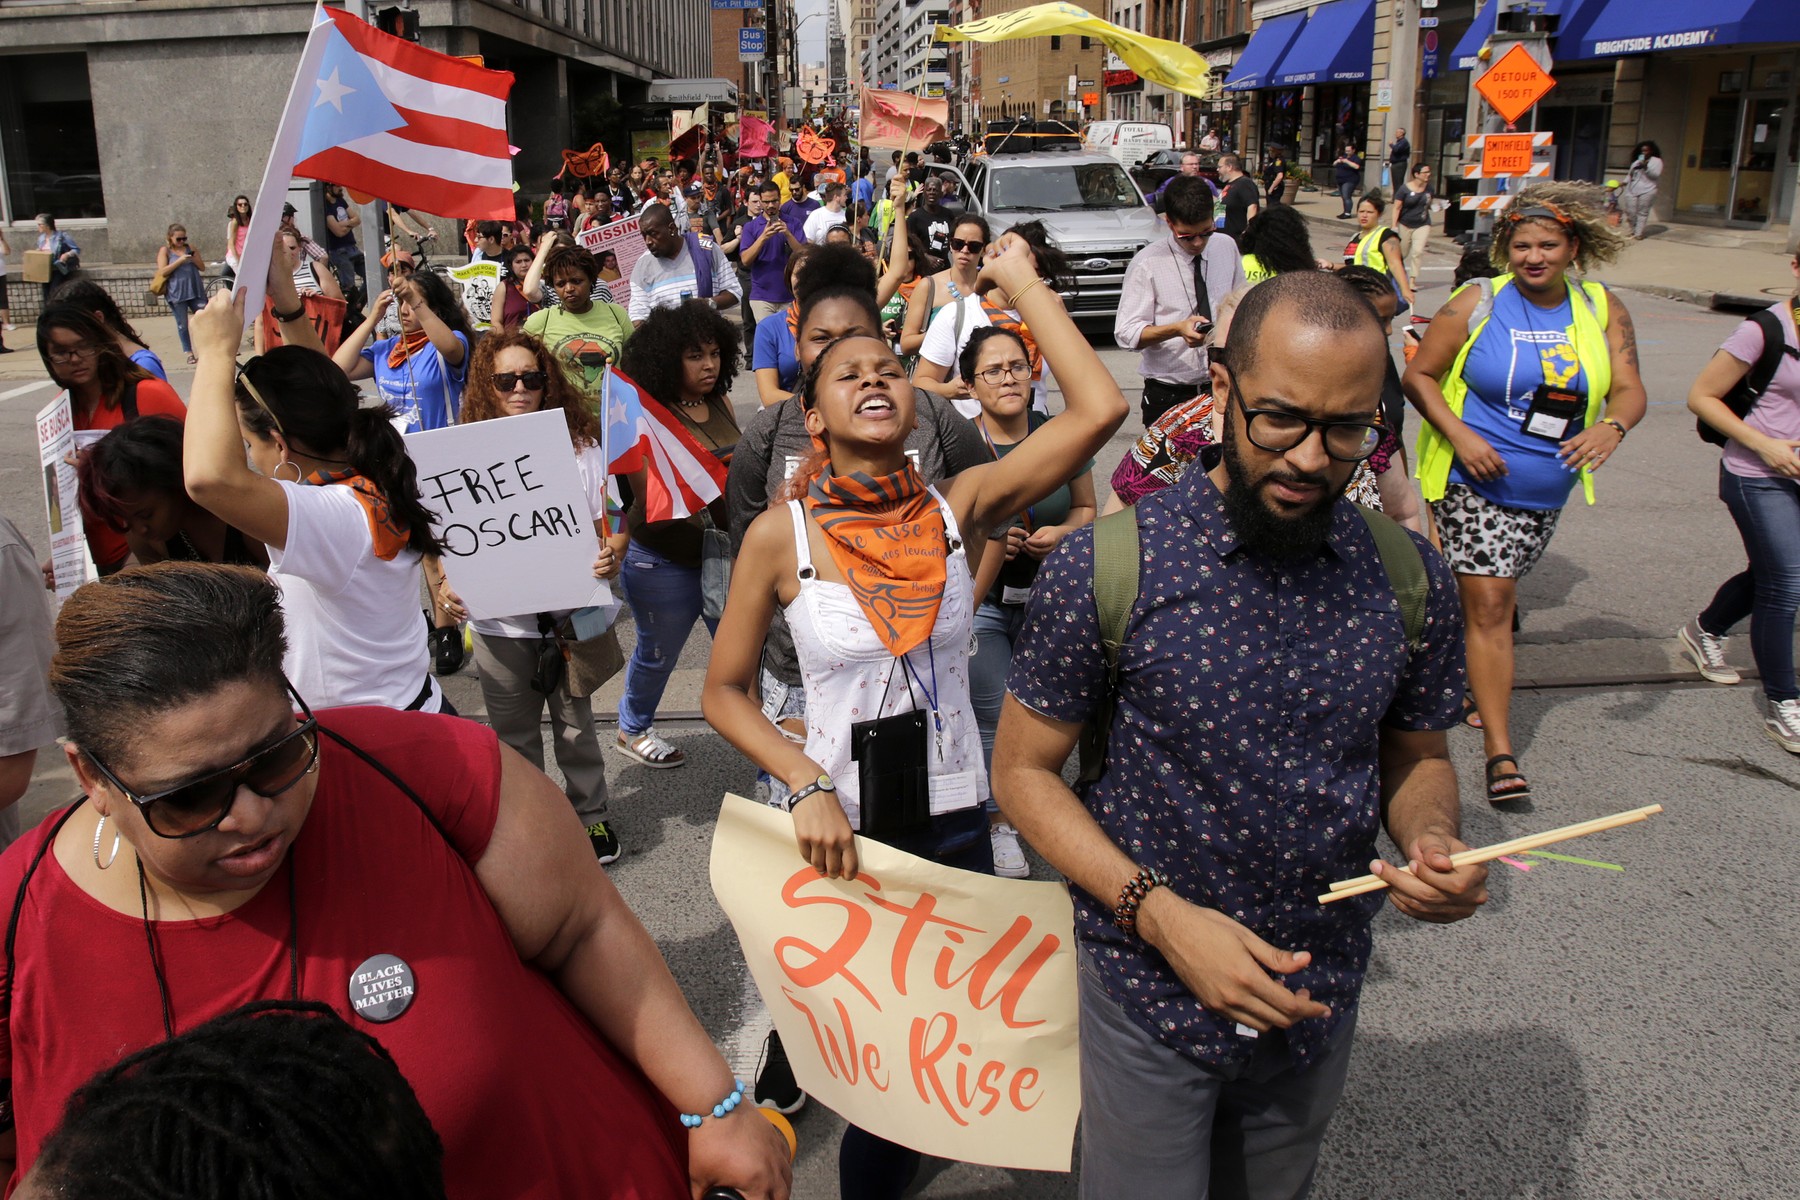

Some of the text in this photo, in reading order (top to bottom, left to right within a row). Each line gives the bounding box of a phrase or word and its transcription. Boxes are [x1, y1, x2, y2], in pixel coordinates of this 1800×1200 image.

[742, 30, 761, 39] Bus
[1594, 30, 1710, 55] BRIGHTSIDE ACADEMY
[741, 41, 763, 51] Stop
[1458, 57, 1477, 69] BRIG
[1493, 71, 1537, 82] DETOUR
[650, 94, 665, 102] One
[668, 93, 702, 102] Smithfield
[704, 93, 723, 101] Street
[1497, 88, 1533, 100] 1500 FT
[1487, 140, 1530, 152] SMITHFIELD
[1491, 156, 1523, 168] STREET
[584, 220, 638, 246] MISSIN
[39, 404, 71, 443] SE BUSCA
[422, 454, 544, 514] FREE
[442, 503, 581, 557] OSCAR!
[872, 523, 923, 542] Rise
[881, 549, 900, 561] nos
[773, 865, 1061, 1029] Still
[357, 963, 405, 985] BLACK
[362, 975, 403, 996] LIVES
[354, 985, 414, 1010] MATTER
[780, 984, 1046, 1128] We Rise
